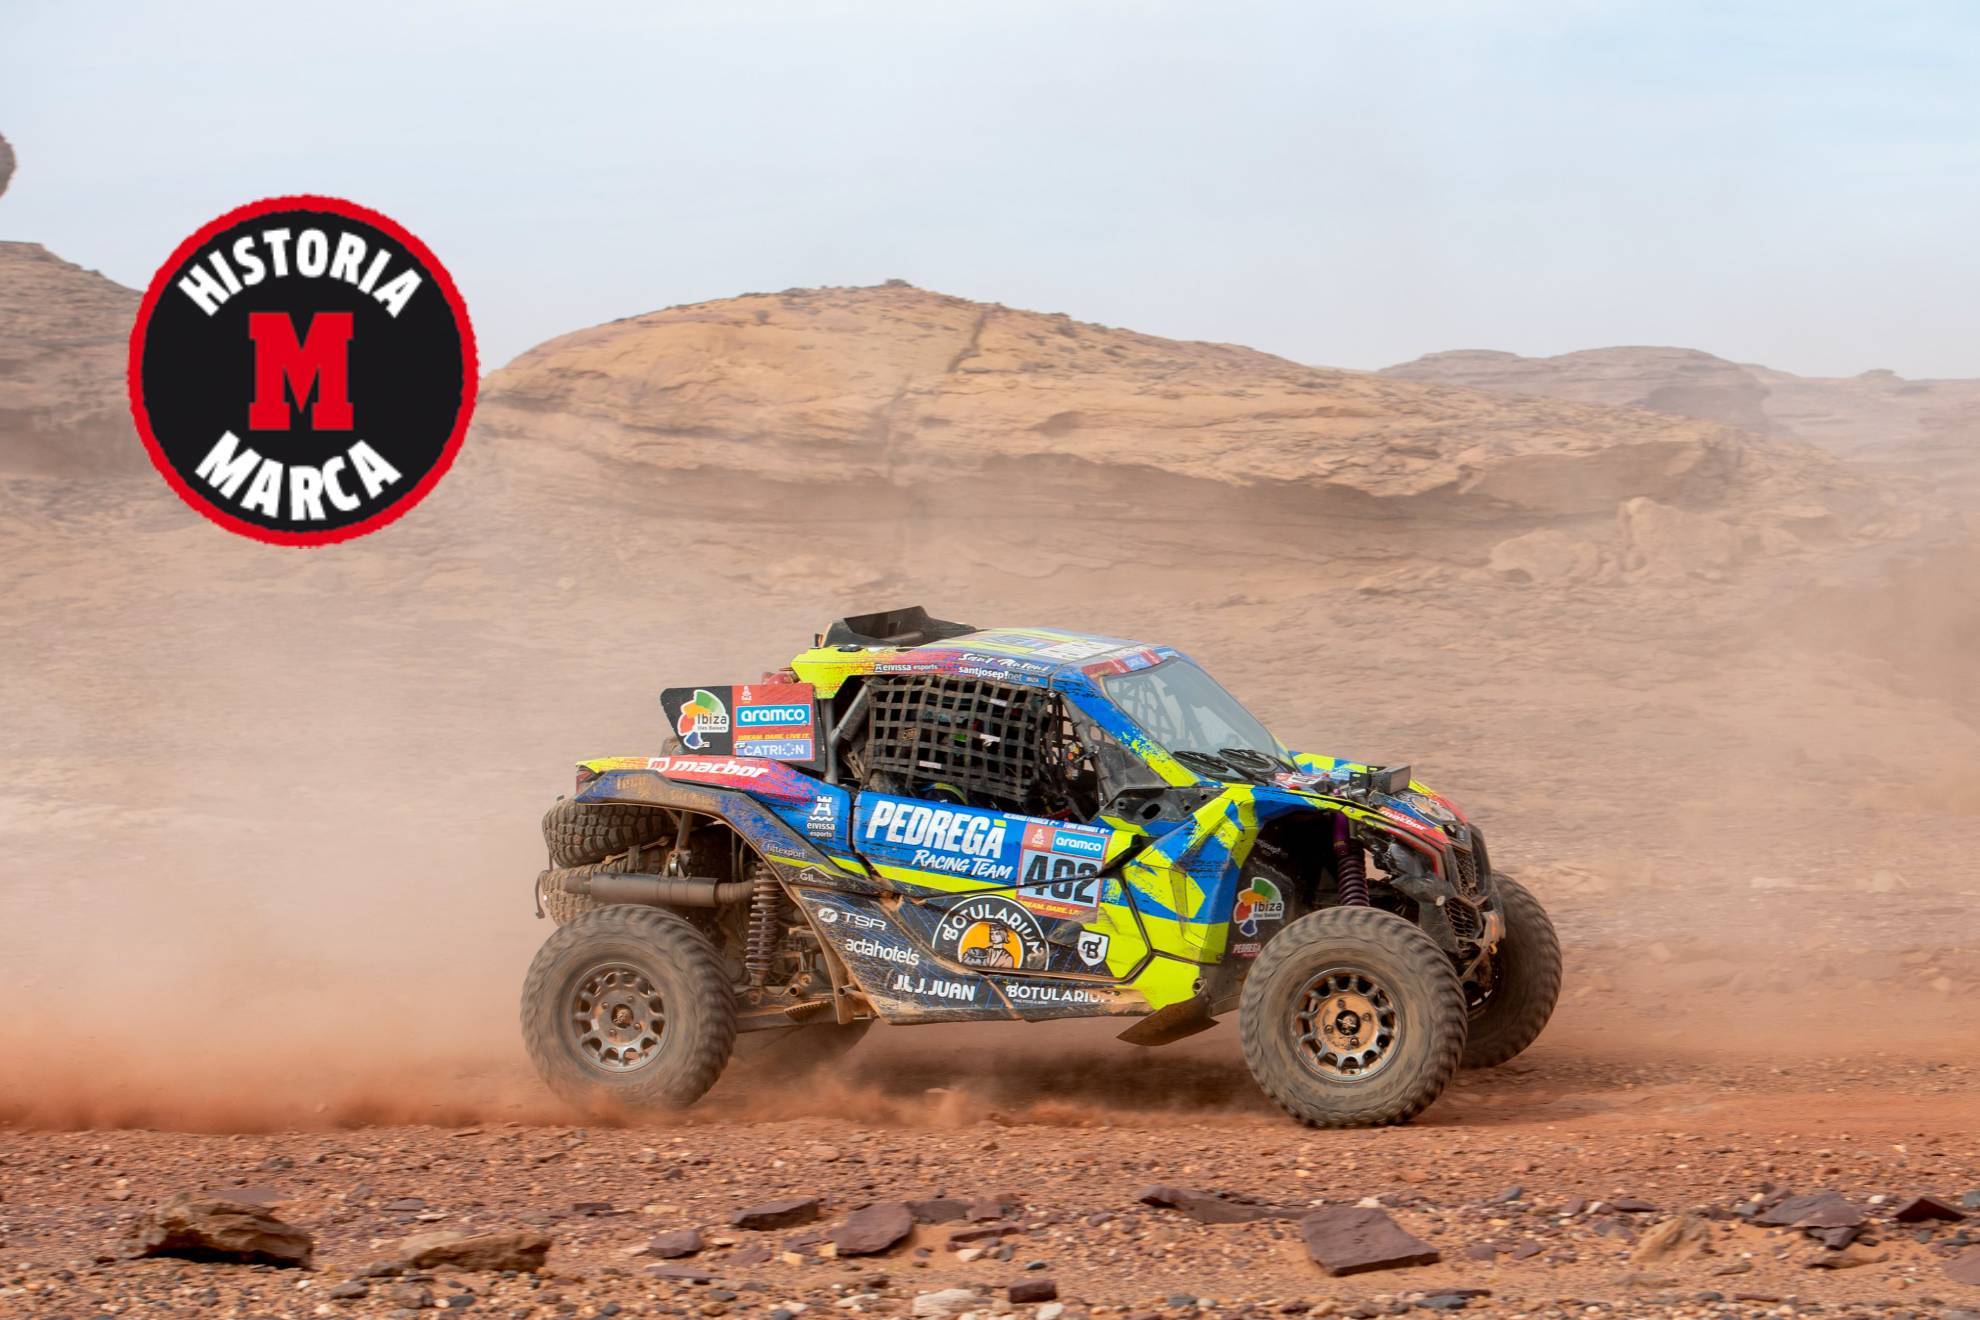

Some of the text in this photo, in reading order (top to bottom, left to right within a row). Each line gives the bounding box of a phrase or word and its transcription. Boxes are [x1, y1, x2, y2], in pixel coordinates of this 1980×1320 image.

[697, 713, 727, 725] Ibiza
[741, 708, 805, 722] aramco
[670, 759, 769, 778] macbor
[1056, 836, 1101, 852] aramco
[911, 849, 1013, 879] RACING TEAM
[1024, 854, 1099, 905] 402
[841, 912, 887, 931] TSR
[845, 939, 920, 966] actahotels
